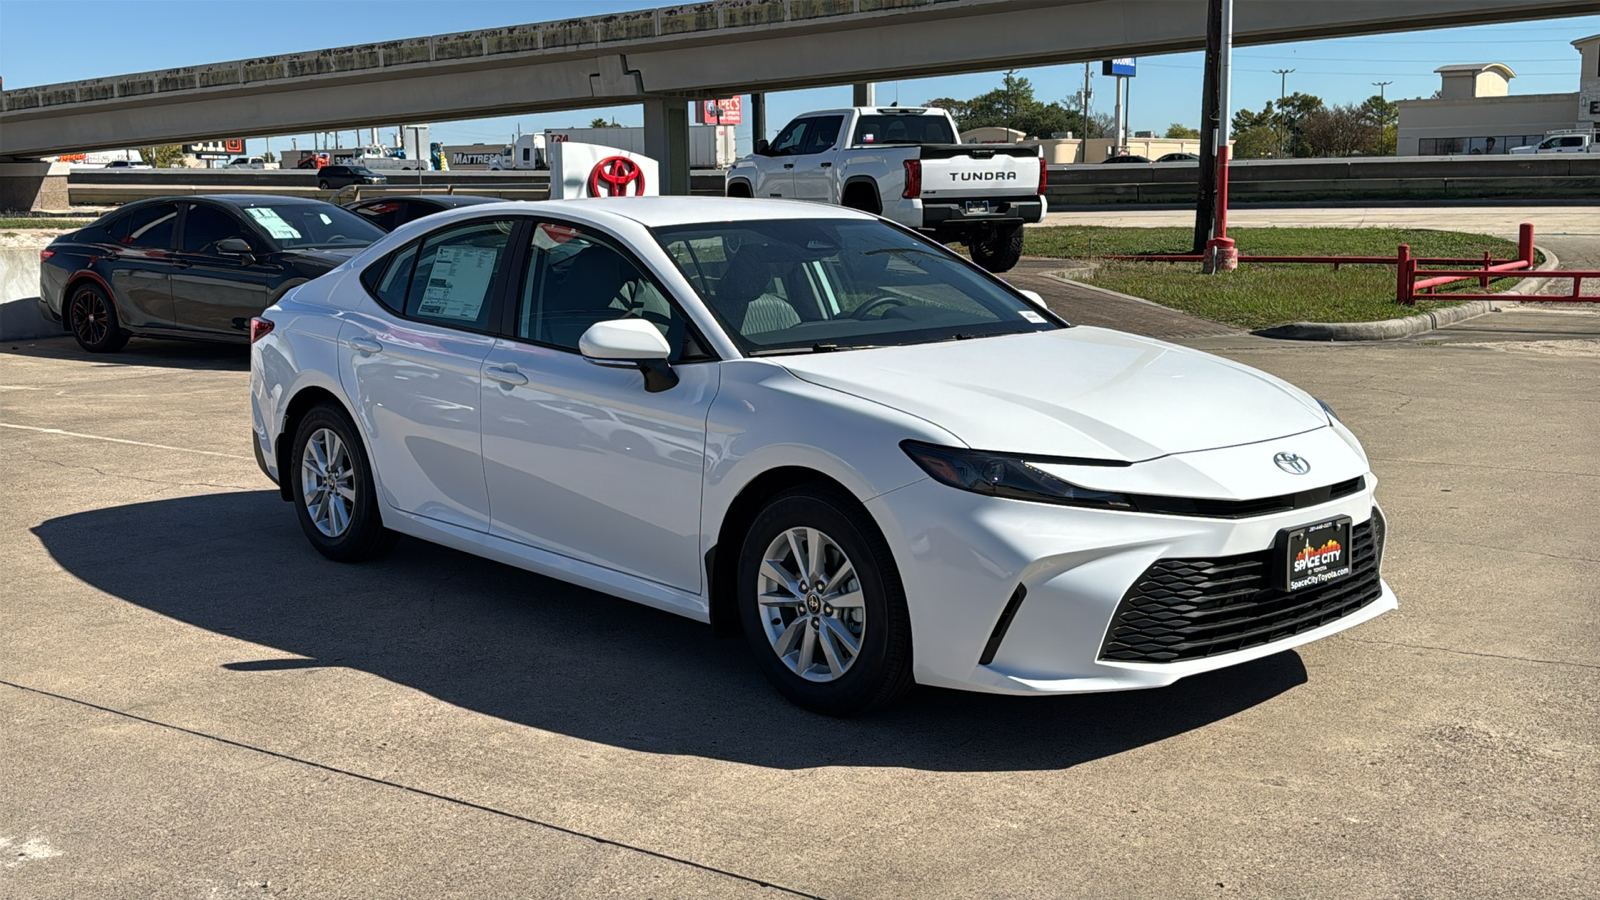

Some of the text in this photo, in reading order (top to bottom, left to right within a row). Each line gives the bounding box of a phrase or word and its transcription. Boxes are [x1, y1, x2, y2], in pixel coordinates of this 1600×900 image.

[949, 171, 1017, 182] TUNDRA
[1294, 549, 1341, 572] SPACE CITY
[1290, 567, 1349, 590] SpaceCityToyota.com
